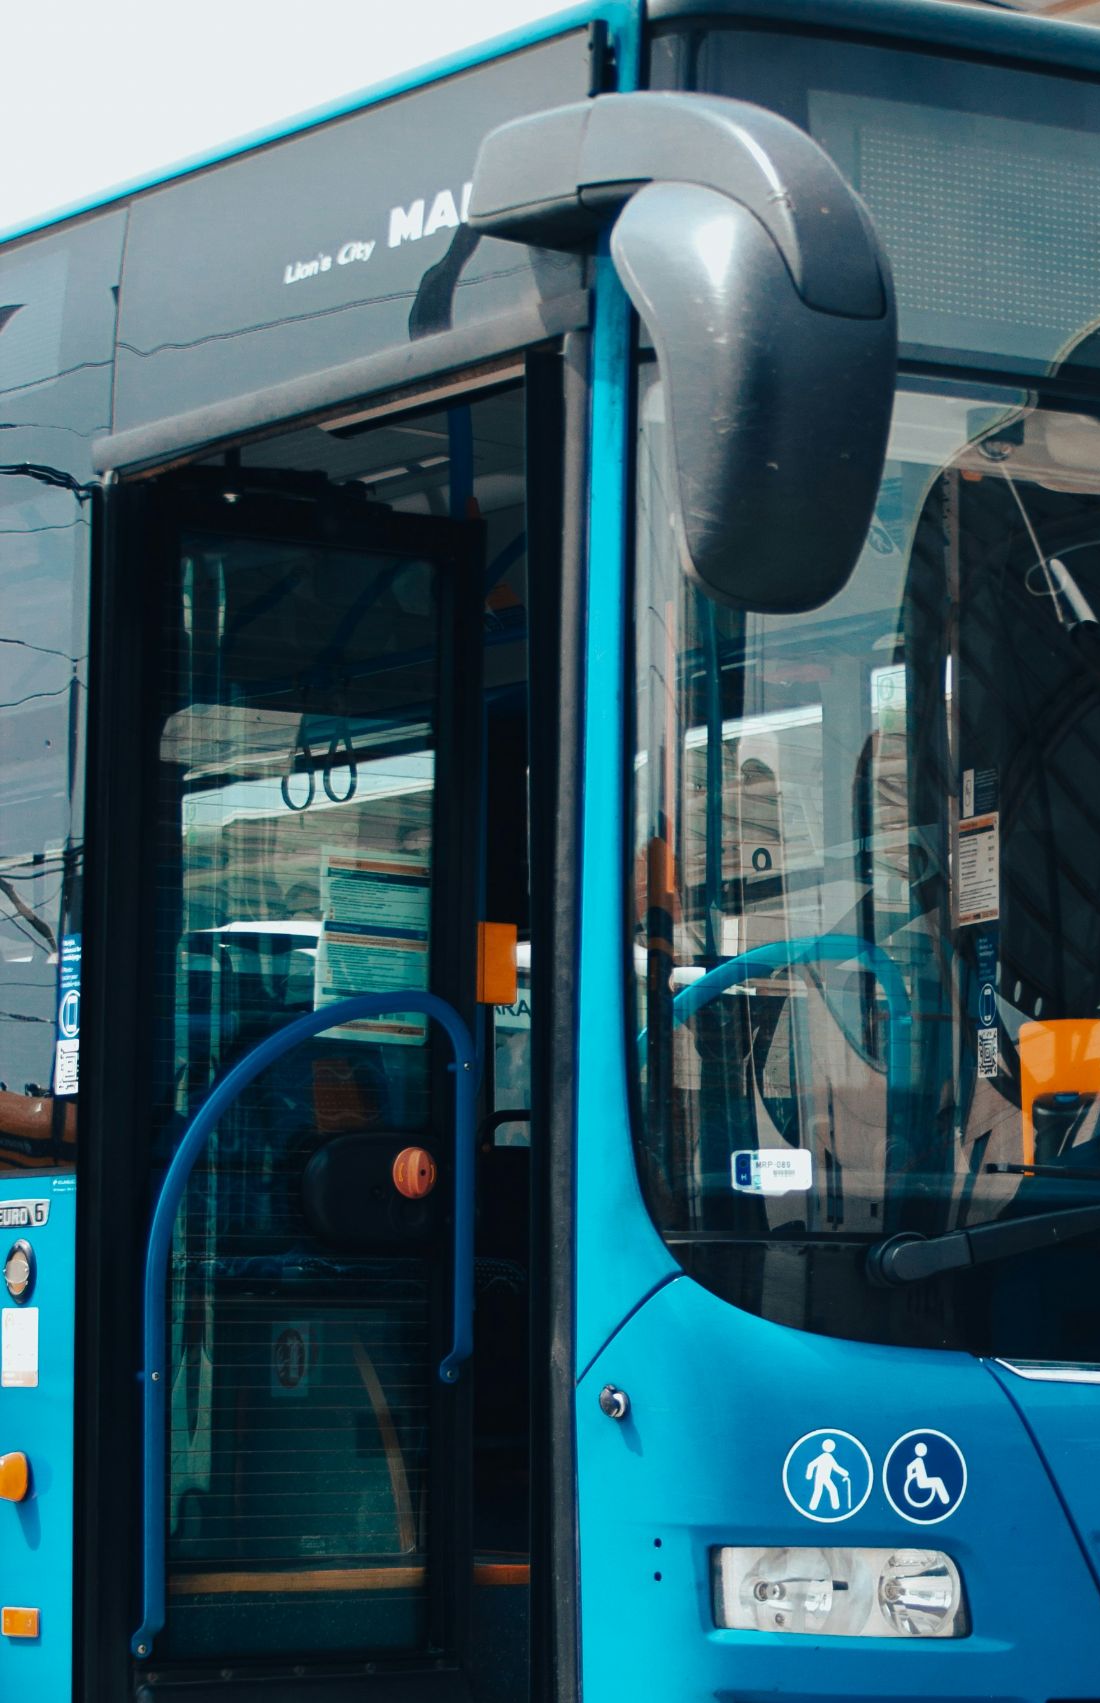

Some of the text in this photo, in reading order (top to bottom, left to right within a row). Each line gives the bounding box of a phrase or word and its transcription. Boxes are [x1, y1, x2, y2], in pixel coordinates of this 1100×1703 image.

[283, 253, 332, 284] Lion's
[337, 239, 375, 265] City
[35, 1202, 44, 1222] 6
